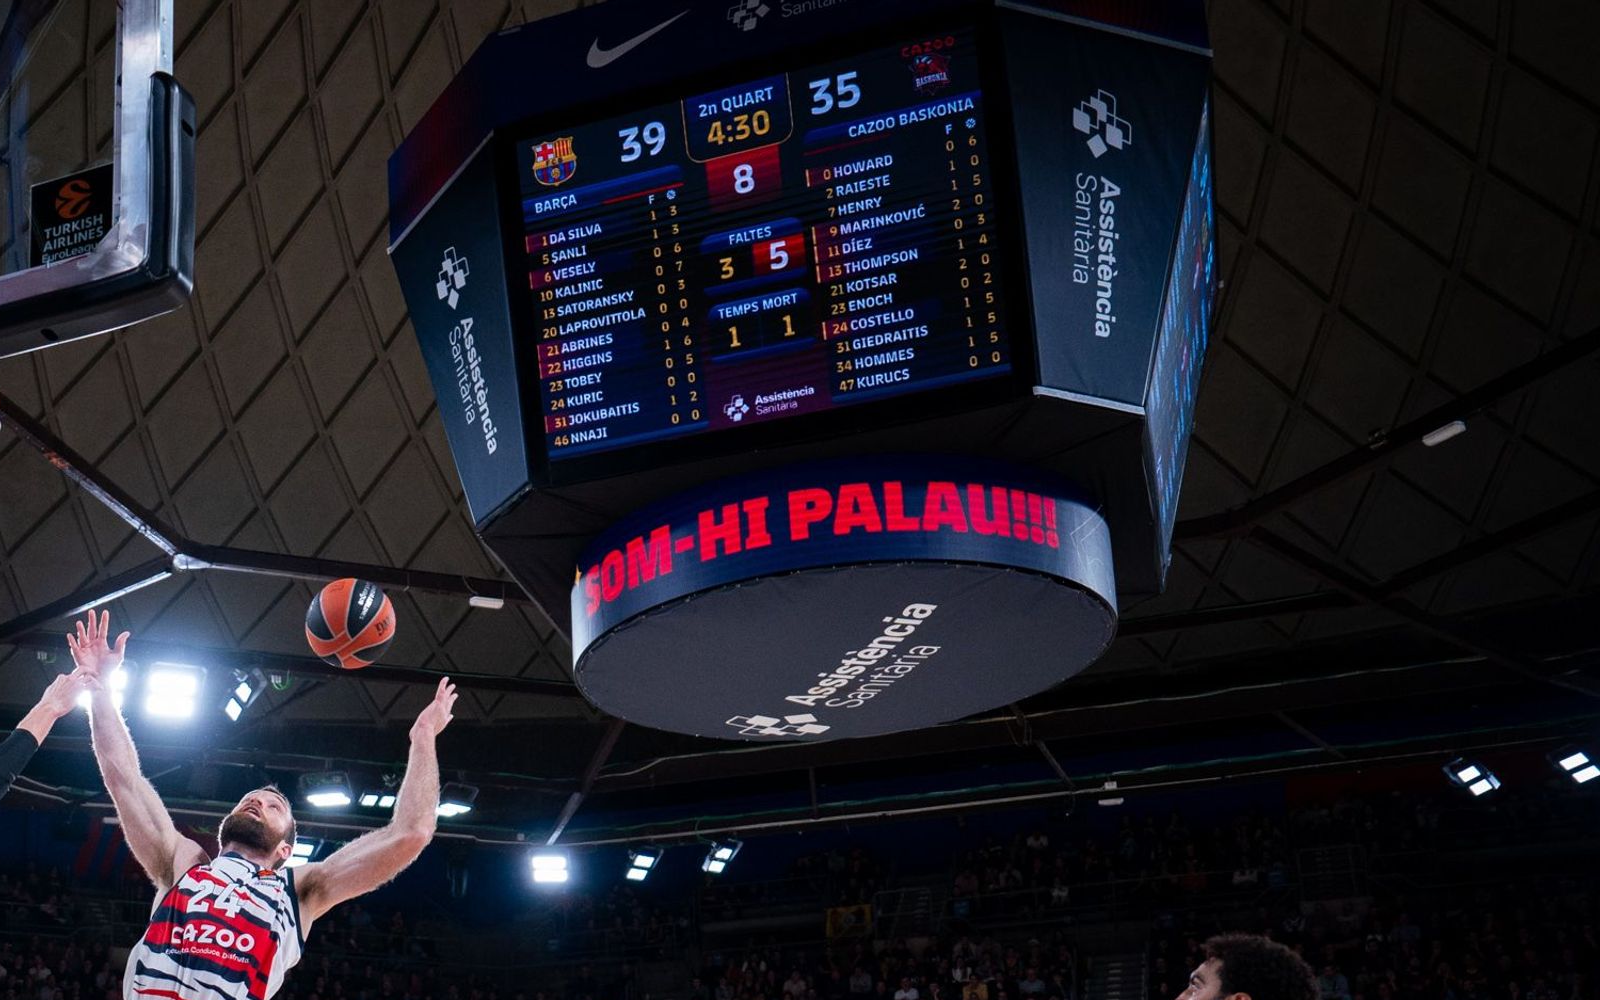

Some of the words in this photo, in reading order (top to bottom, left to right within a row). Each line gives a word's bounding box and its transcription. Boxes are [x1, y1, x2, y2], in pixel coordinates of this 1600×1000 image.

[699, 104, 717, 118] 2n
[721, 87, 774, 113] QUART
[808, 71, 861, 115] 35
[707, 109, 771, 146] 4:30
[849, 116, 895, 138] CAZOO
[899, 97, 974, 126] BASKONIA
[618, 121, 666, 163] 39
[823, 168, 831, 181] 0
[833, 154, 893, 178] HOWARD
[969, 135, 977, 147] 6
[733, 164, 755, 195] 8
[826, 188, 833, 199] 2
[836, 174, 891, 197] RAIESTE
[970, 155, 979, 166] 0
[828, 206, 836, 218] 7
[837, 196, 882, 216] HENRY
[972, 174, 981, 186] 5
[535, 194, 578, 214] BARÇA
[829, 226, 837, 237] 9
[840, 203, 926, 235] MARINKOVIĆ
[974, 194, 983, 206] 0
[43, 226, 104, 253] AIRLINES
[44, 213, 103, 240] TURKISH
[542, 236, 548, 246] 1
[550, 231, 566, 245] DA
[568, 223, 602, 240] SILVA
[670, 205, 678, 216] 3
[542, 254, 550, 265] 5
[551, 245, 587, 264] ŞANLI
[672, 224, 680, 234] 3
[729, 226, 772, 246] FALTES
[827, 245, 840, 257] 11
[842, 237, 873, 255] DÍEZ
[978, 213, 986, 225] 3
[1072, 172, 1098, 285] Sanitària
[544, 272, 551, 283] 6
[553, 261, 596, 281] VESELY
[674, 242, 682, 253] 6
[719, 257, 735, 280] 3
[770, 240, 789, 271] 5
[828, 265, 842, 278] 13
[844, 248, 919, 274] THOMPSON
[979, 234, 988, 244] 4
[830, 284, 844, 296] 21
[846, 273, 897, 293] KOTSAR
[981, 253, 990, 265] 0
[1095, 176, 1121, 338] Assistència
[540, 290, 553, 302] 10
[555, 279, 604, 299] KALINIC
[676, 261, 683, 272] 7
[543, 308, 555, 320] 13
[557, 290, 634, 317] SATORANSKY
[678, 279, 686, 290] 3
[831, 303, 846, 316] 23
[848, 293, 893, 312] ENOCH
[984, 272, 992, 284] 2
[542, 327, 557, 340] 20
[559, 307, 646, 336] LAPROVITTOLA
[679, 299, 688, 310] 0
[718, 302, 759, 319] TEMPS
[762, 293, 798, 311] MORT
[832, 322, 848, 335] 24
[850, 308, 915, 331] COSTELLO
[986, 292, 994, 304] 5
[547, 345, 559, 356] 21
[561, 333, 614, 354] ABRINES
[681, 317, 690, 328] 4
[728, 326, 741, 348] 1
[782, 314, 795, 337] 1
[836, 341, 850, 354] 31
[852, 325, 929, 350] GIEDRAITIS
[988, 312, 996, 323] 5
[547, 362, 562, 375] 22
[563, 351, 613, 372] HIGGINS
[684, 335, 692, 346] 6
[549, 380, 563, 392] 23
[565, 372, 602, 389] TOBEY
[686, 354, 694, 365] 5
[836, 360, 853, 373] 34
[854, 348, 915, 370] HOMMES
[990, 332, 998, 343] 5
[839, 379, 855, 392] 47
[856, 368, 910, 389] KURUCS
[992, 351, 1000, 363] 0
[450, 326, 477, 425] Sanitària
[460, 317, 498, 455] Assistència
[551, 399, 565, 411] 24
[567, 391, 603, 408] KURIC
[688, 372, 696, 383] 0
[755, 385, 815, 405] Assistència
[554, 417, 567, 428] 31
[568, 402, 640, 426] JOKUBAITIS
[690, 391, 698, 402] 2
[554, 436, 569, 447] 46
[570, 427, 608, 444] NNAJI
[691, 409, 700, 420] 0
[585, 496, 774, 618] SOM-HI
[787, 481, 1060, 549] PALAU!!!
[785, 602, 937, 708] Assistència
[825, 645, 942, 710] Sanitària
[186, 879, 242, 919] 24
[170, 923, 255, 952] CAZOO
